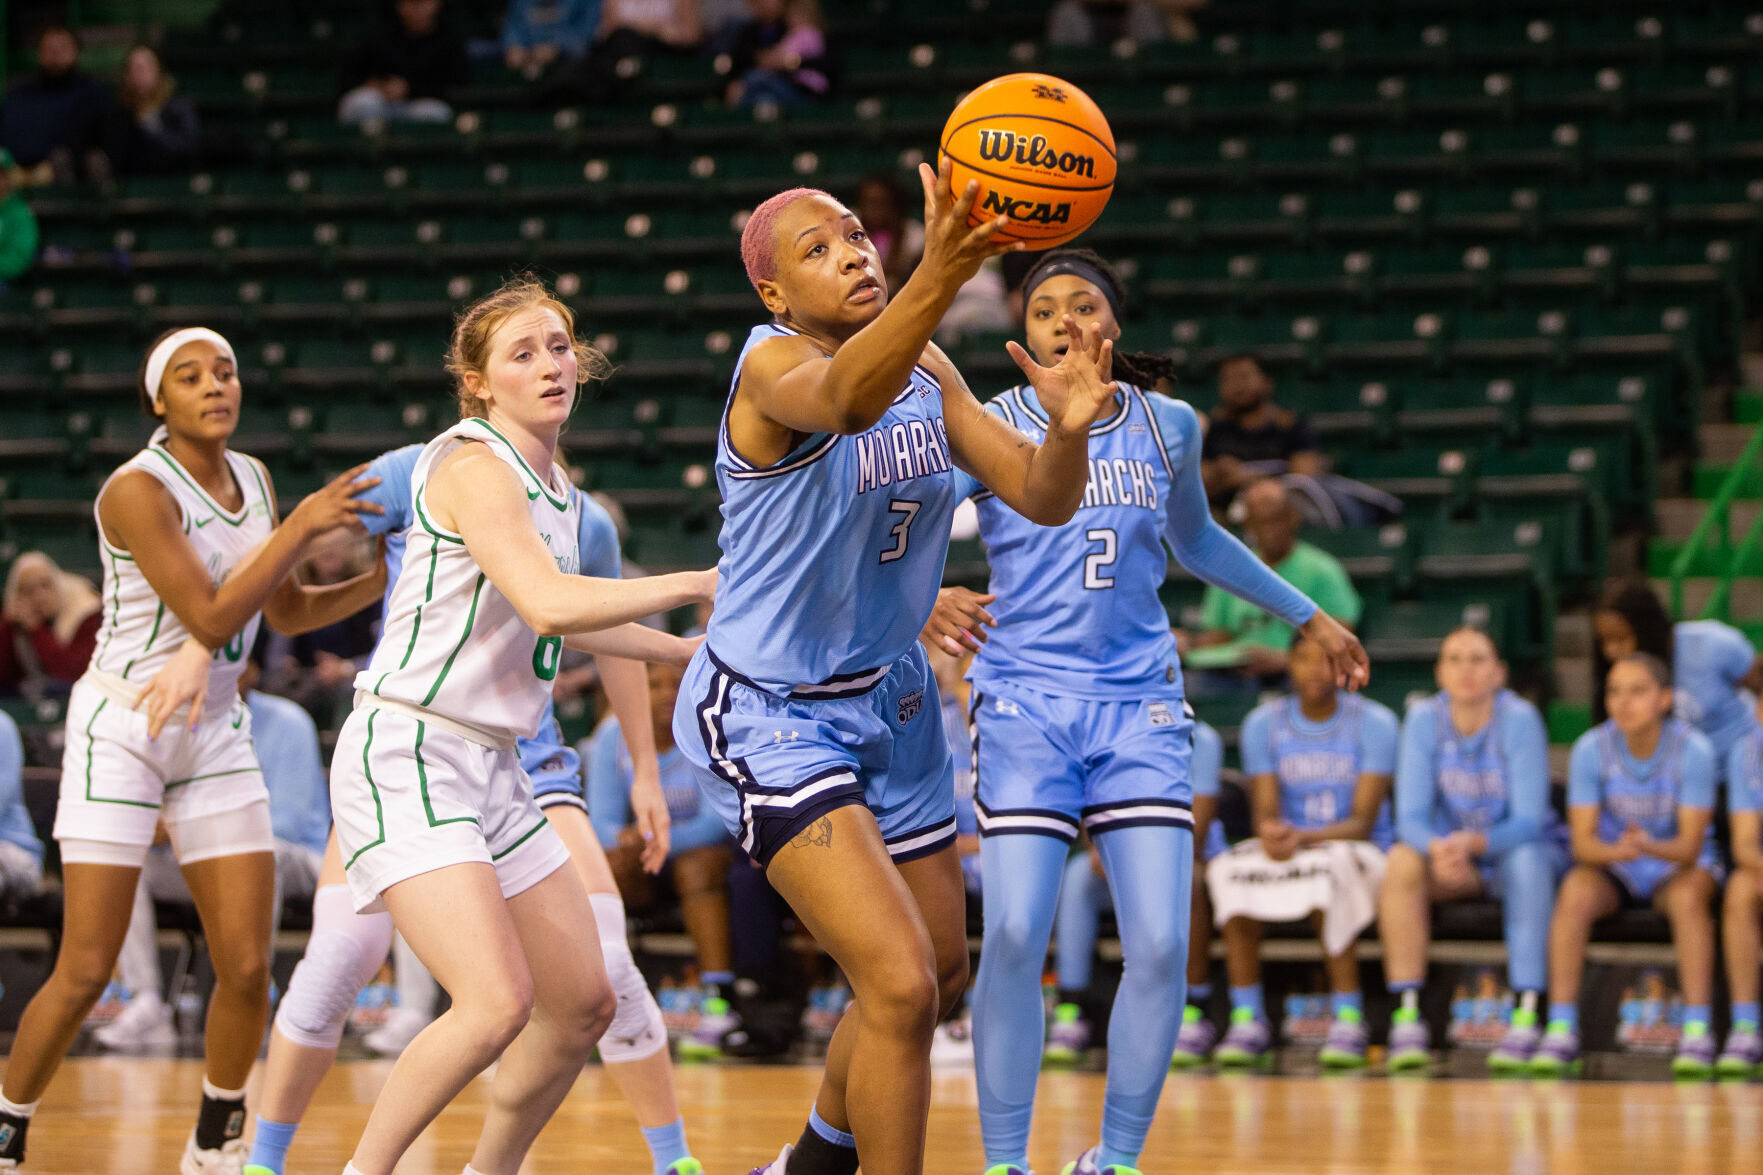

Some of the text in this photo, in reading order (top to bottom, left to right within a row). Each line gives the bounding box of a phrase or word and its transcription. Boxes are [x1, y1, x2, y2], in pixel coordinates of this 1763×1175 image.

[979, 129, 1095, 179] Wilson
[981, 189, 1073, 224] NCAA
[1079, 457, 1158, 511] ARCHS
[878, 499, 922, 565] 3
[1083, 528, 1118, 591] 2
